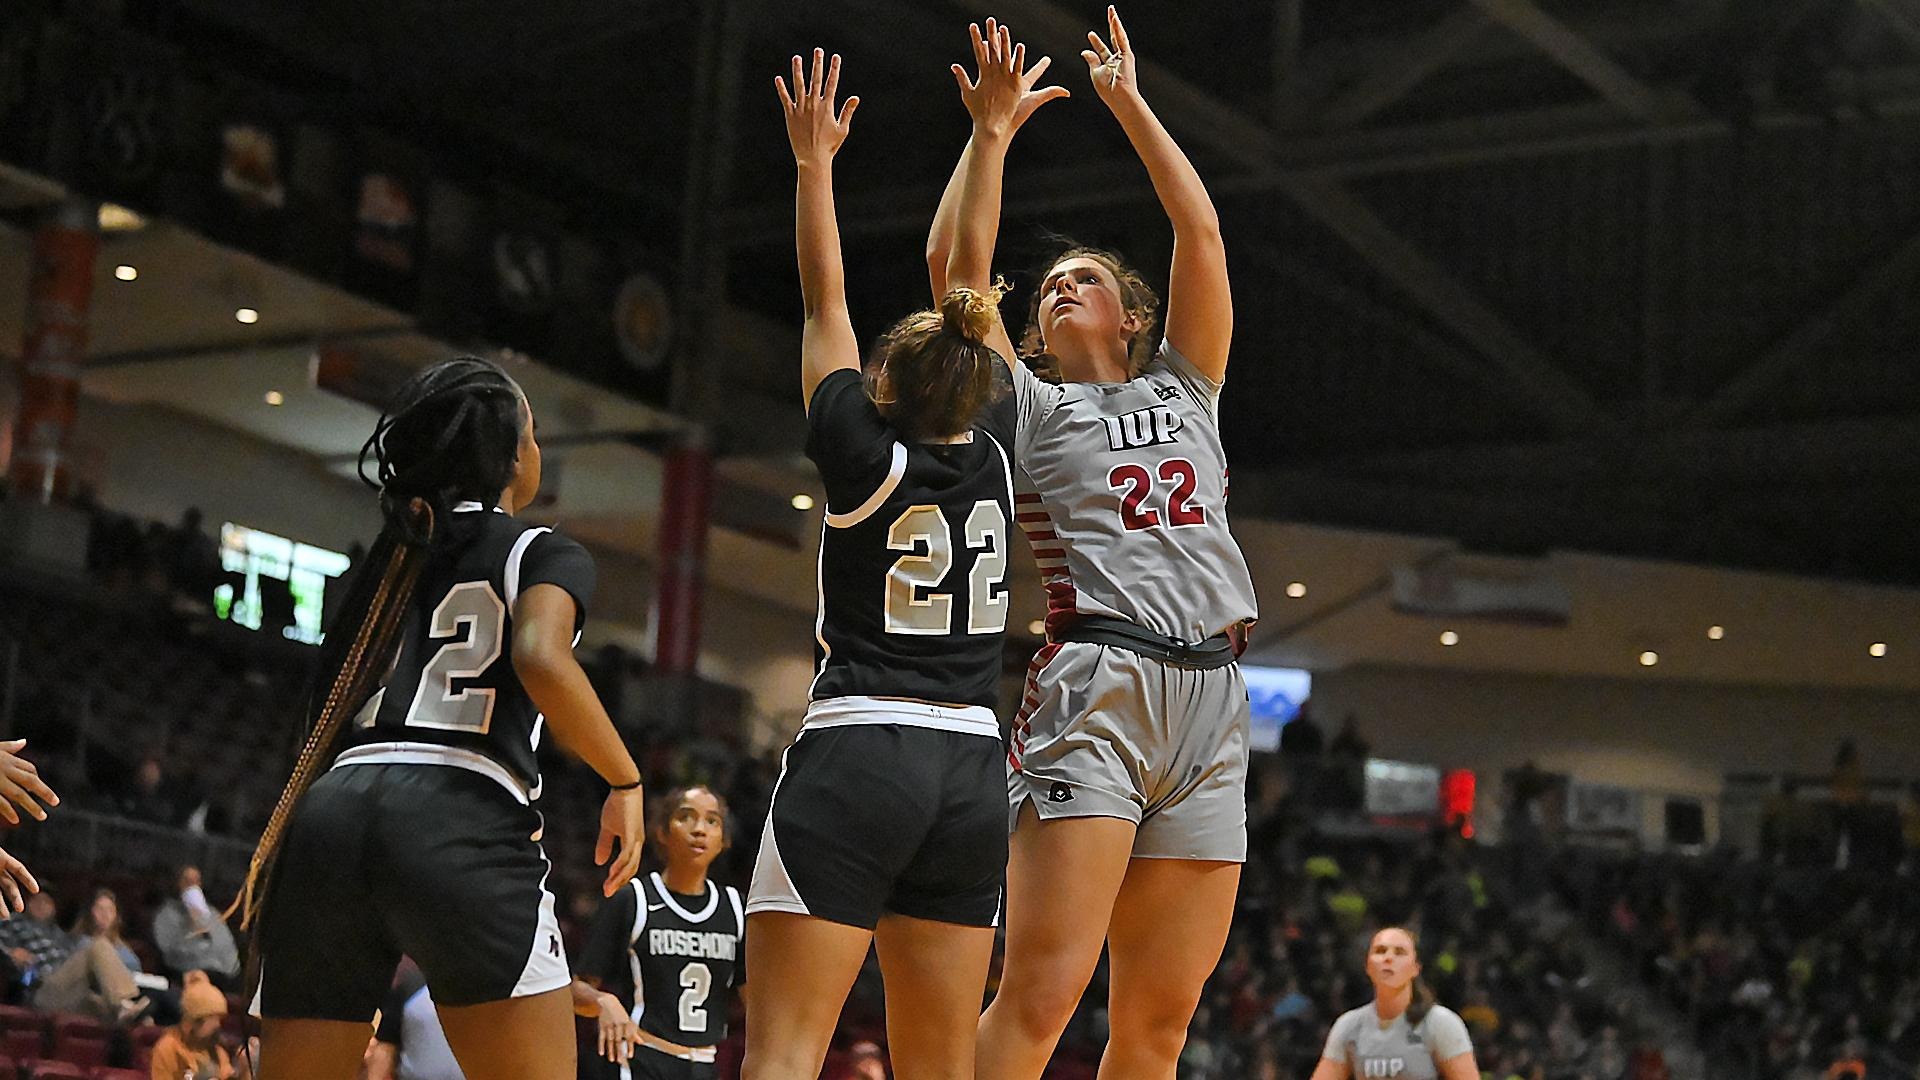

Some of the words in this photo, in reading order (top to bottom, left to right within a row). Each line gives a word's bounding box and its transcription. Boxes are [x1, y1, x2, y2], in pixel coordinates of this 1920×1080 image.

[1098, 404, 1184, 452] IUP
[1106, 457, 1208, 534] 22
[885, 499, 1009, 635] 22
[353, 580, 505, 735] 2
[678, 962, 712, 1032] 2
[1363, 1057, 1405, 1079] IUP
